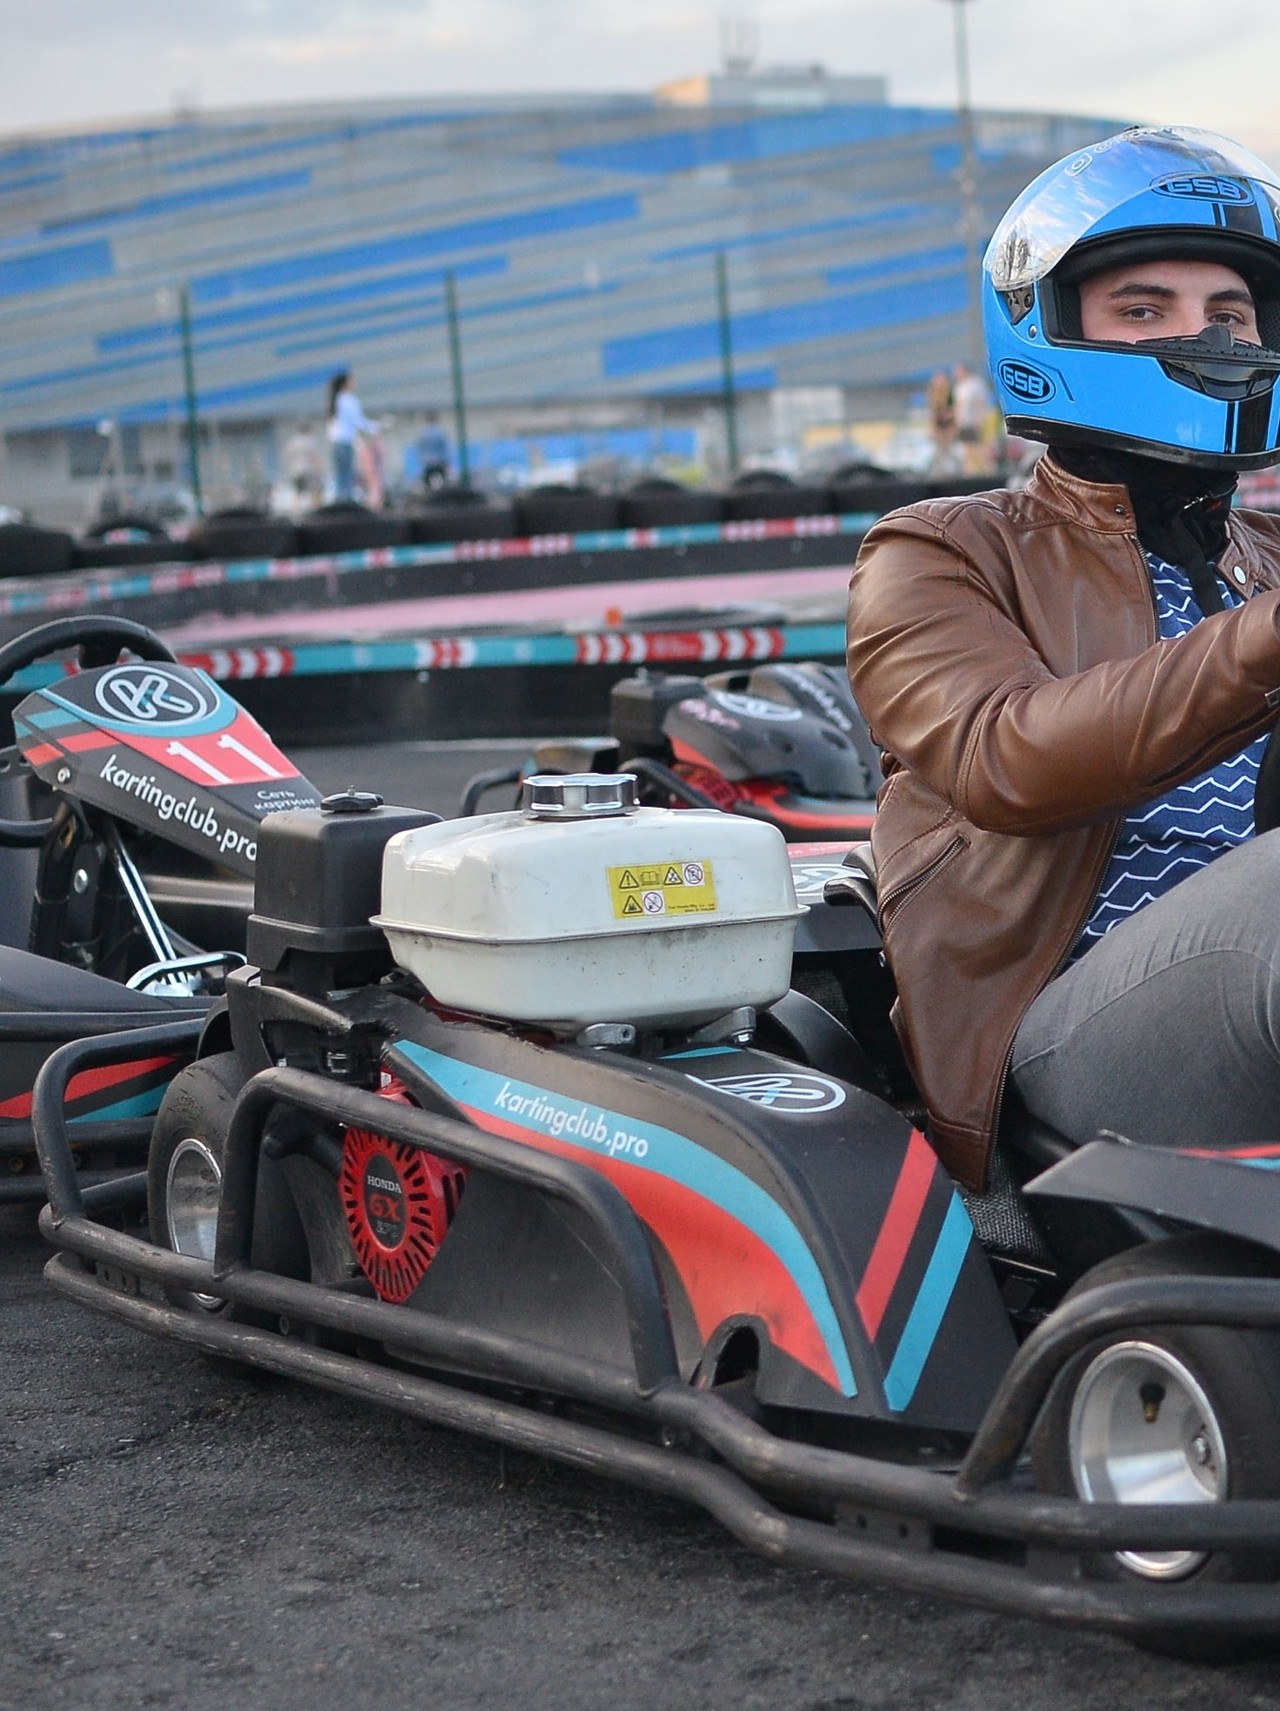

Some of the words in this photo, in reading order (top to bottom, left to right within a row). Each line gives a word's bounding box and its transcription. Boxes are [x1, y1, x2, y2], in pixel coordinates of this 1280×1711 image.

[1166, 178, 1241, 199] GSB
[1003, 365, 1044, 397] GSB
[165, 733, 284, 785] 11
[100, 753, 258, 862] kartingclub.pro
[494, 1081, 649, 1158] kartingclub.pro
[367, 1175, 402, 1194] HONDA
